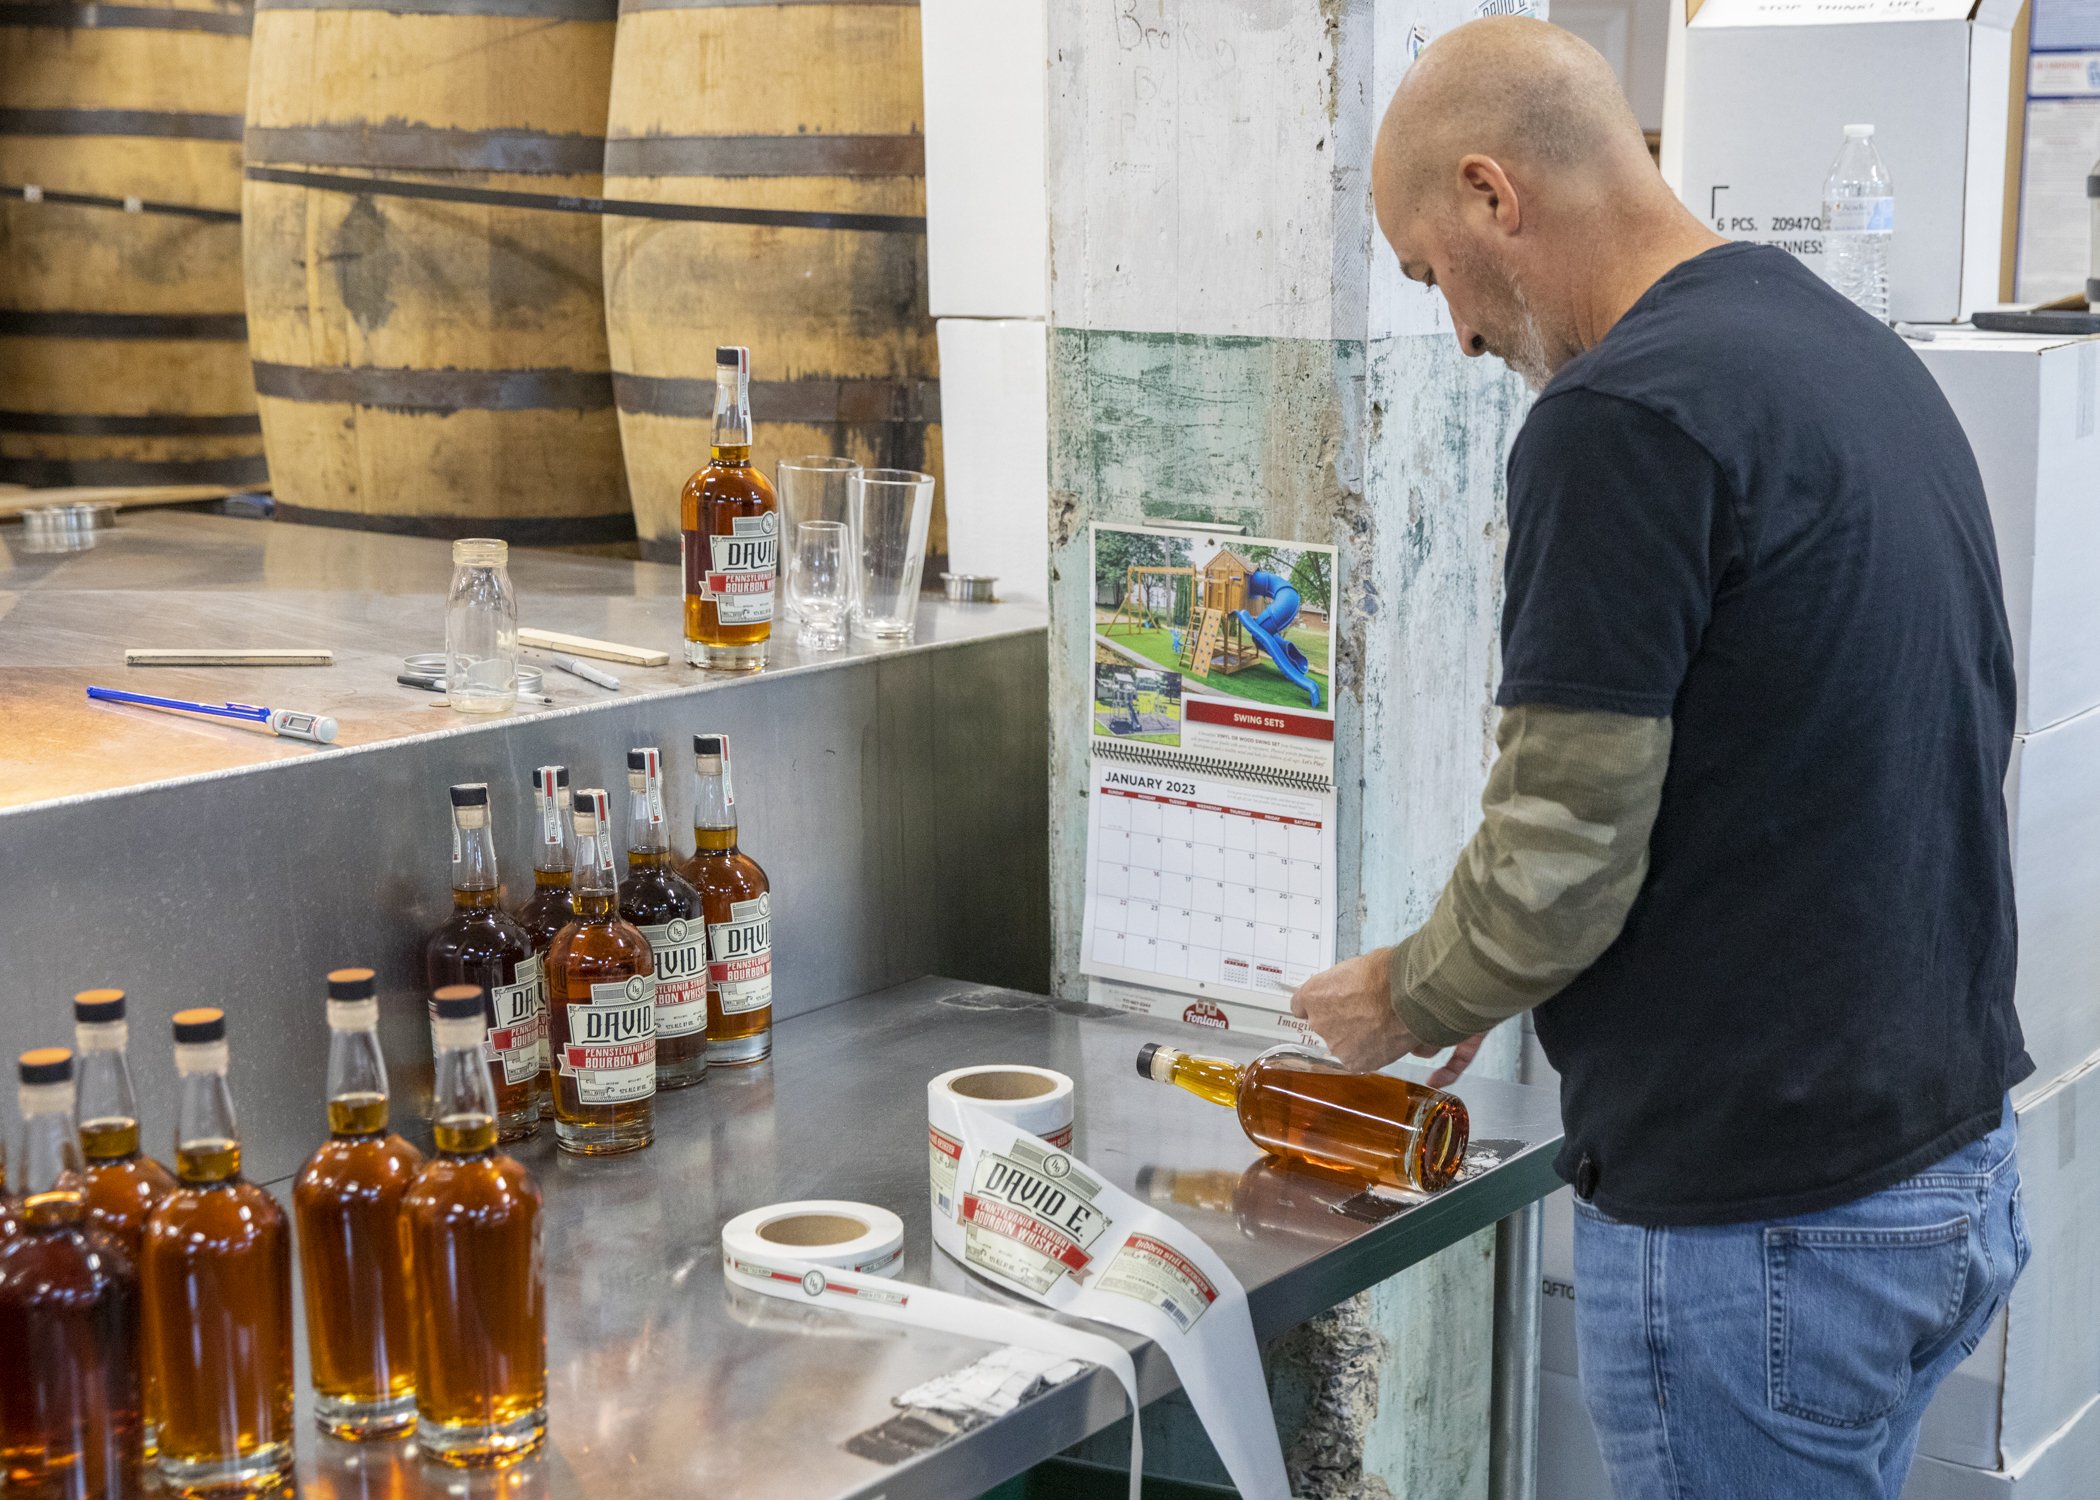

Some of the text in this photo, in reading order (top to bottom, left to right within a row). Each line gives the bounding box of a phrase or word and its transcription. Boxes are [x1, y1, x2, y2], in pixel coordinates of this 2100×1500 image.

[1717, 217, 1725, 231] 6
[1731, 217, 1758, 232] PCS.
[726, 580, 766, 592] BOURBON
[1234, 713, 1284, 728] SWING SETS
[1105, 772, 1196, 795] JANUARY 2023
[728, 966, 765, 981] BOURBON
[587, 1005, 650, 1041] DAVID
[1186, 1011, 1226, 1028] Fontana
[585, 1043, 644, 1057] PENNSYLVANIA
[585, 1055, 634, 1068] BOURBON
[986, 1163, 1091, 1237] DAVID E.
[977, 1201, 1071, 1250] PENNSYLVANIA STRAIGHT
[973, 1210, 1067, 1259] BOURBON WHISKEY
